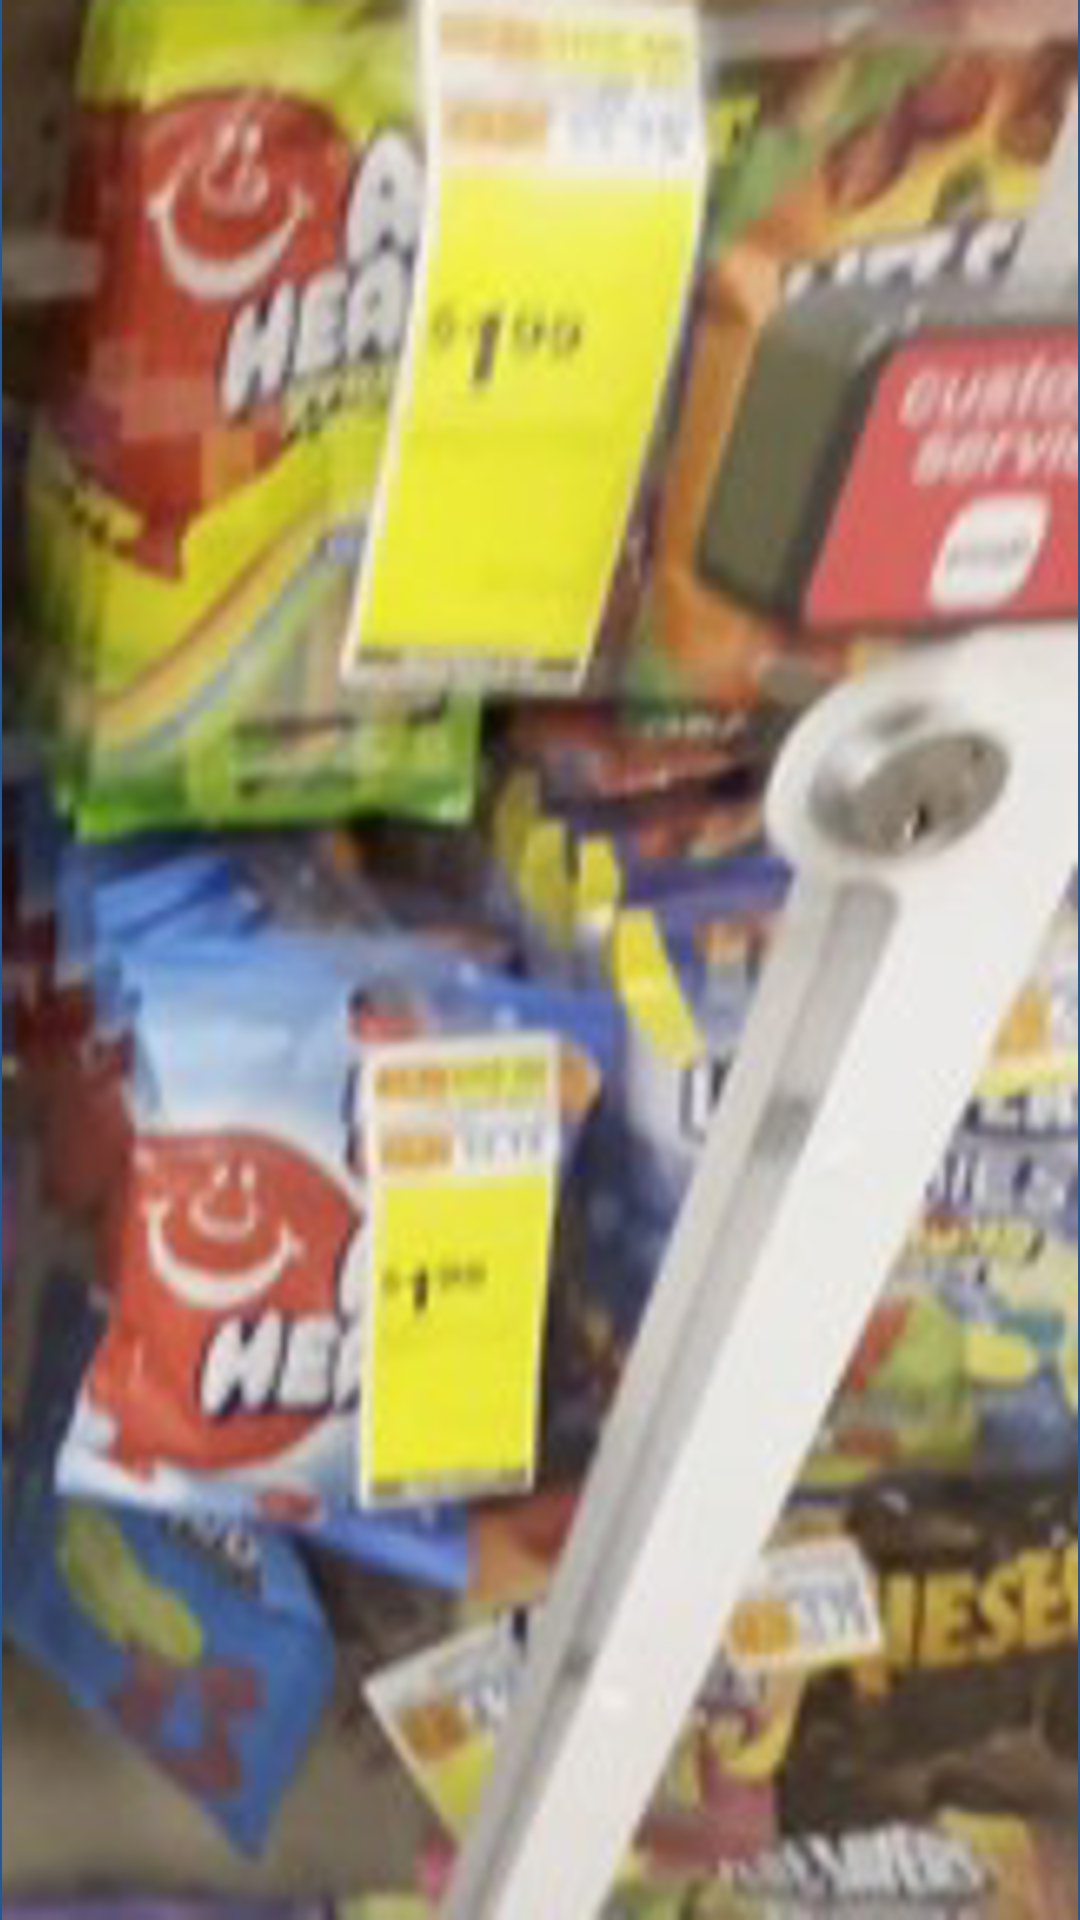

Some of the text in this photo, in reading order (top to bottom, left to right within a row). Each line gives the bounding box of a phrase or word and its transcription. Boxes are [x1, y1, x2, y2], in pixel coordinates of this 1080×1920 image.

[345, 125, 422, 262] A
[223, 252, 412, 418] HEA
[900, 355, 1078, 432] custo
